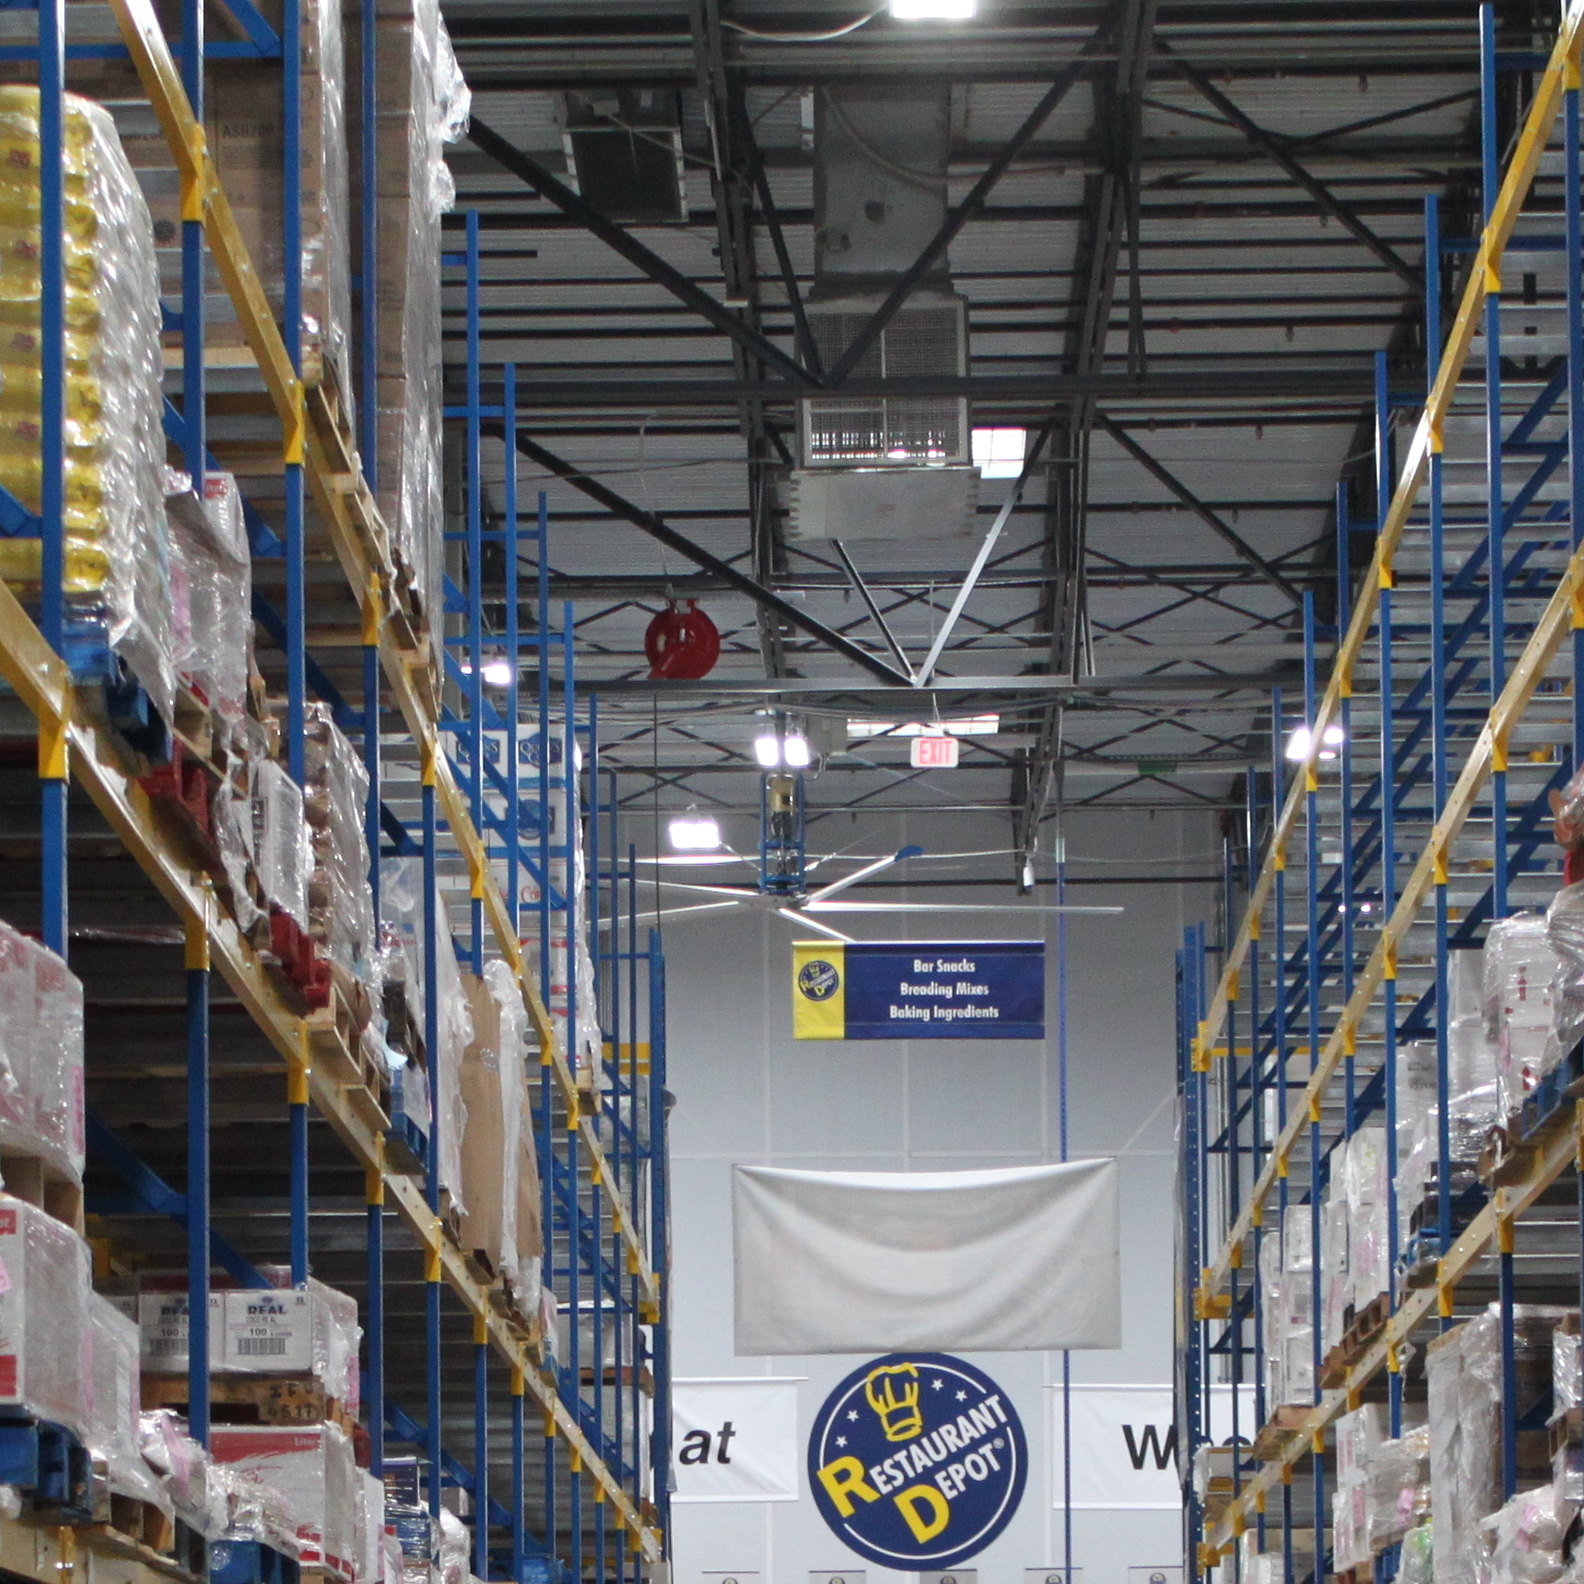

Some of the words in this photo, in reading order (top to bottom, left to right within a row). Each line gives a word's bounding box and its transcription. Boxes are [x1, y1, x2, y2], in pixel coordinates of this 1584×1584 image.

[919, 740, 953, 765] EXIT
[913, 959, 934, 973] Bar
[937, 958, 976, 973] Snacks
[900, 982, 953, 999] Breading
[956, 982, 989, 996] Mixes
[890, 1004, 930, 1022] Baking
[933, 1004, 999, 1021] Ingredients
[249, 1327, 268, 1336] 100
[816, 1393, 1008, 1518] RESTAURANT
[892, 1443, 1002, 1545] DEPOT
